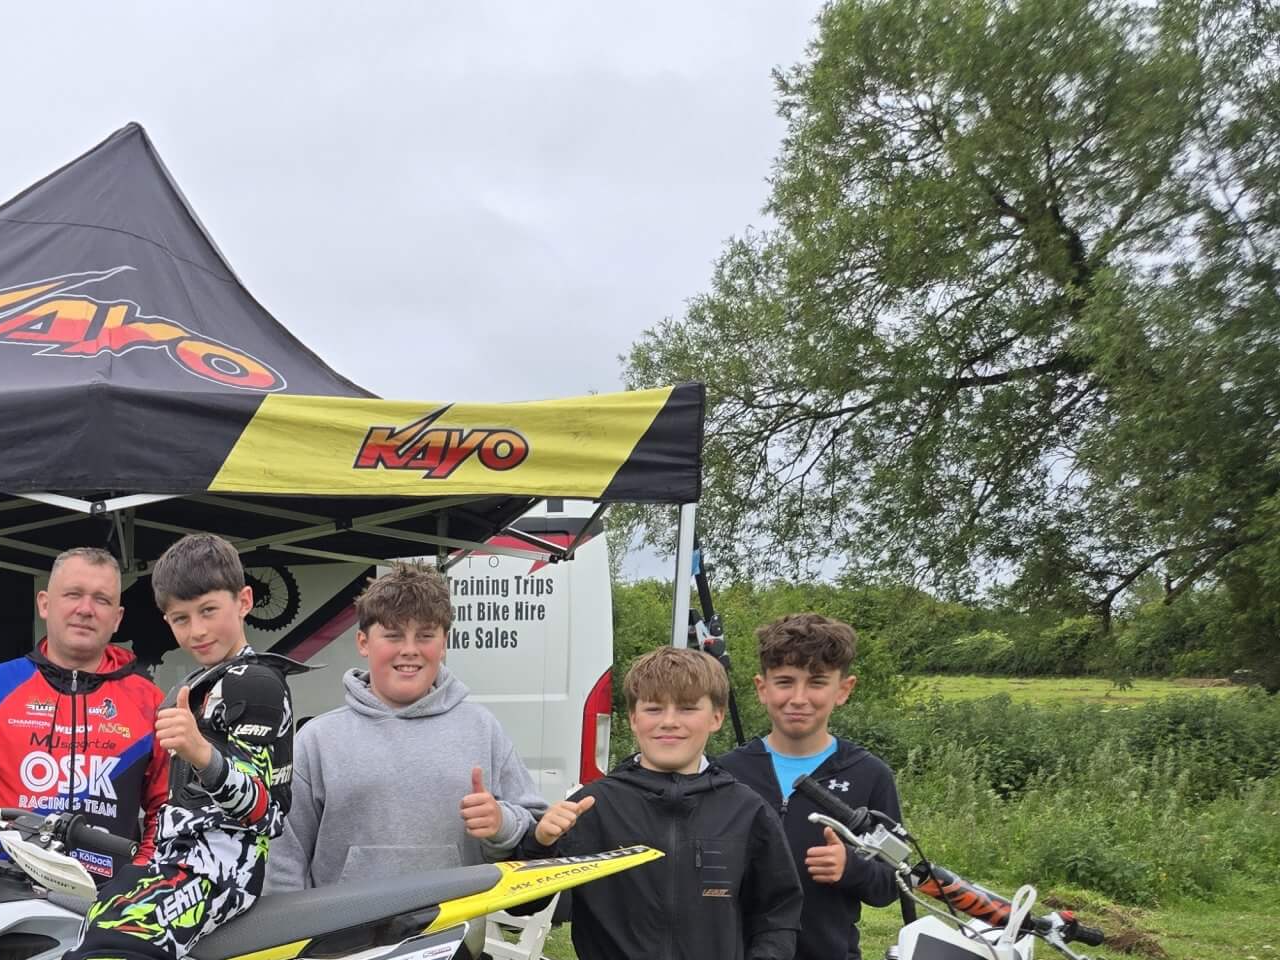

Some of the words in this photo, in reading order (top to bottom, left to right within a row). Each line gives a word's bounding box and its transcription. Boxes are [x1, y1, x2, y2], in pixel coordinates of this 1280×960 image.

[353, 404, 530, 479] KAYO
[447, 576, 509, 598] Training
[514, 575, 554, 596] Trips
[451, 603, 472, 621] ent
[477, 602, 510, 621] Bike
[515, 601, 546, 621] Hire
[447, 628, 470, 649] ike
[475, 627, 518, 649] Sales
[233, 724, 273, 737] LEATT
[19, 751, 122, 800] OSK
[270, 764, 293, 786] EATT
[18, 795, 81, 811] RACING
[83, 798, 117, 818] TEAM
[510, 881, 533, 891] MX
[536, 863, 600, 884] FACTORY
[155, 876, 203, 927] LEATT
